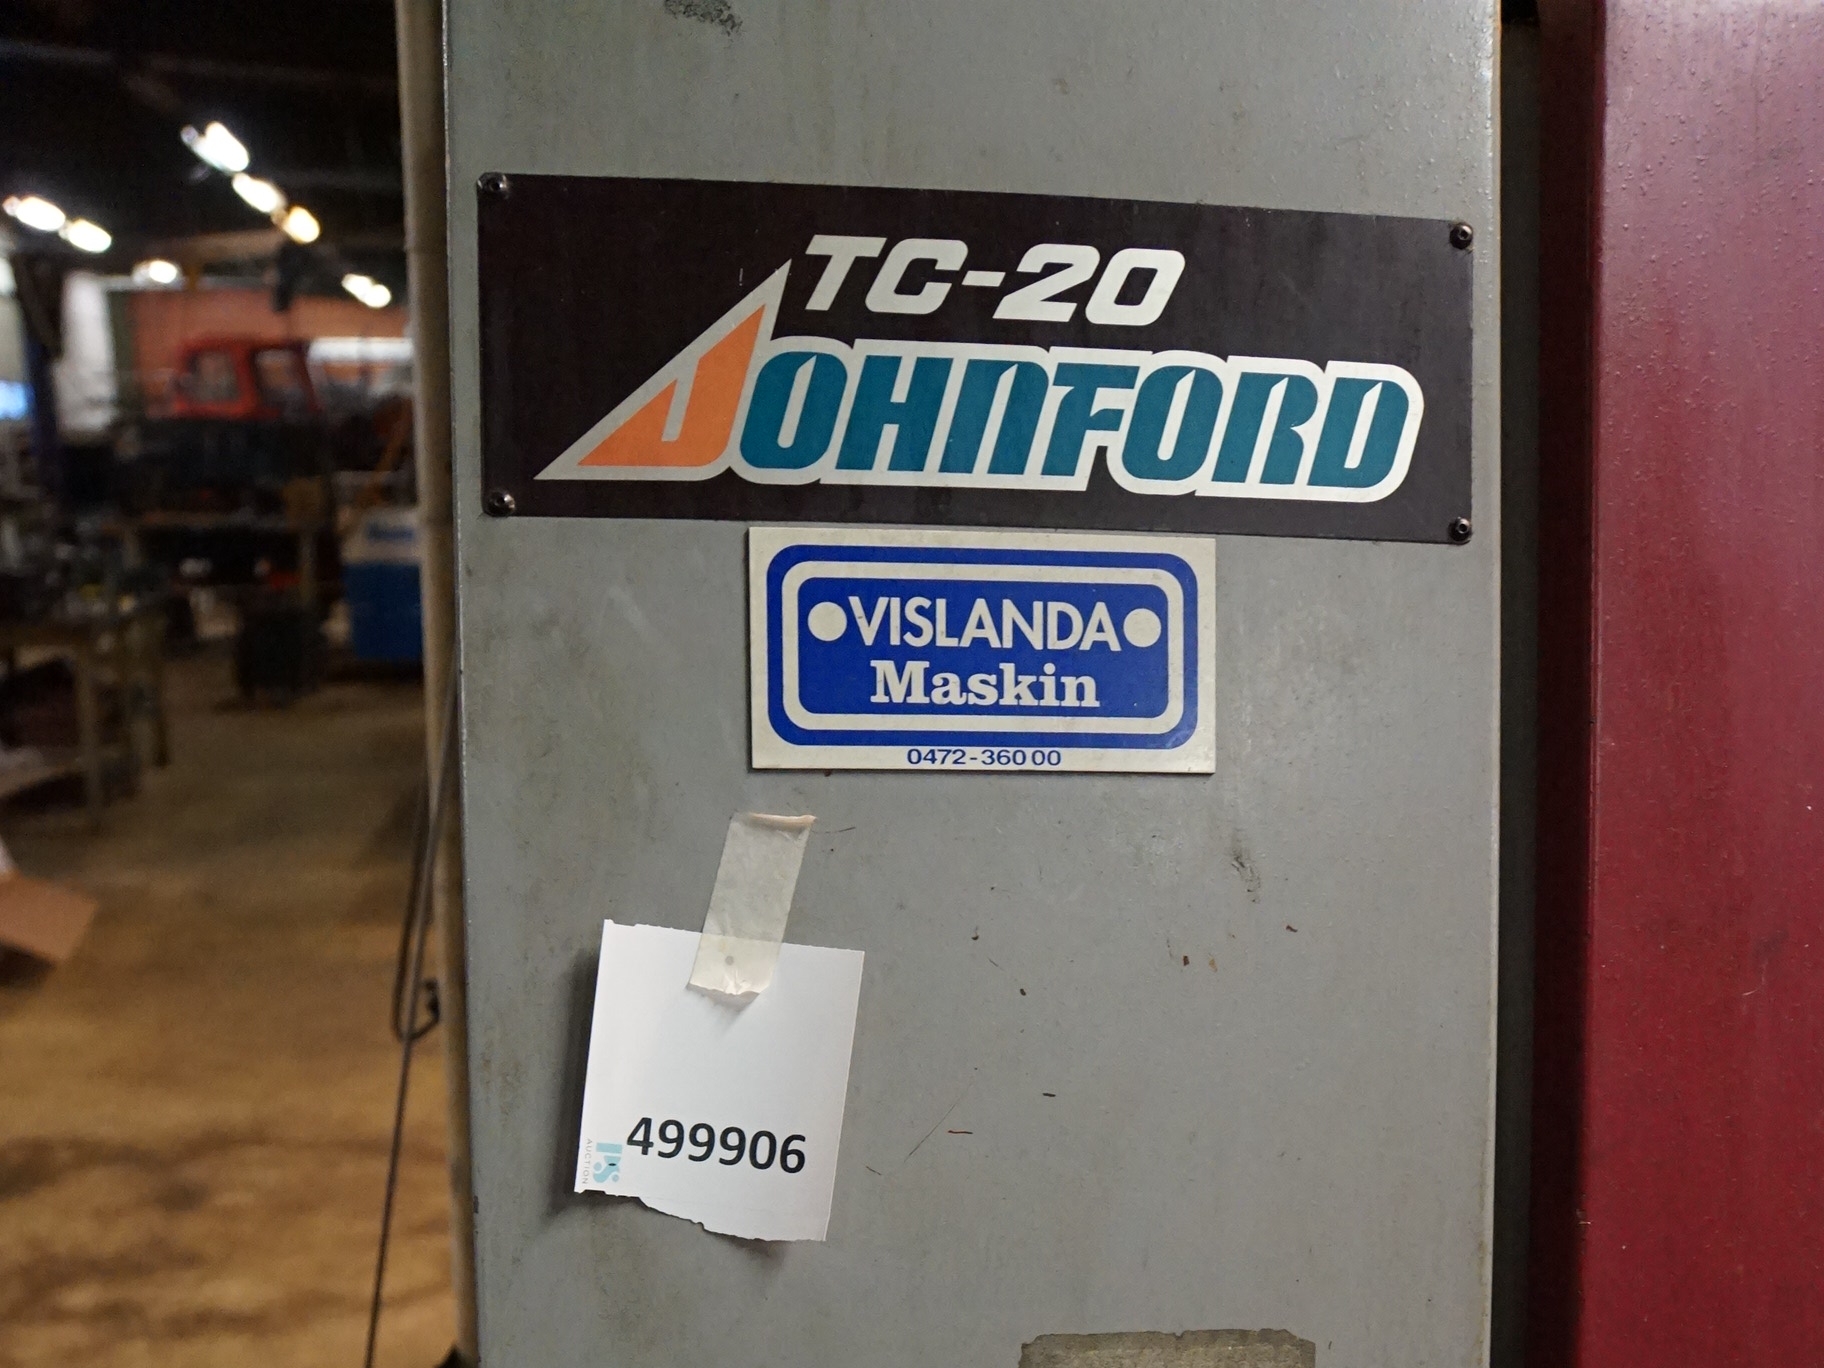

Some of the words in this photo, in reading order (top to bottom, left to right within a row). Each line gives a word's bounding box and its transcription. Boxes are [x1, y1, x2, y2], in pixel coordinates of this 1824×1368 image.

[804, 235, 1186, 327] TC-20
[536, 260, 1425, 503] JOHNFORD
[848, 595, 1122, 652] VISLANDA
[870, 659, 1100, 708] Maskin
[581, 1137, 593, 1185] AUCTION
[626, 1116, 806, 1174] 499906
